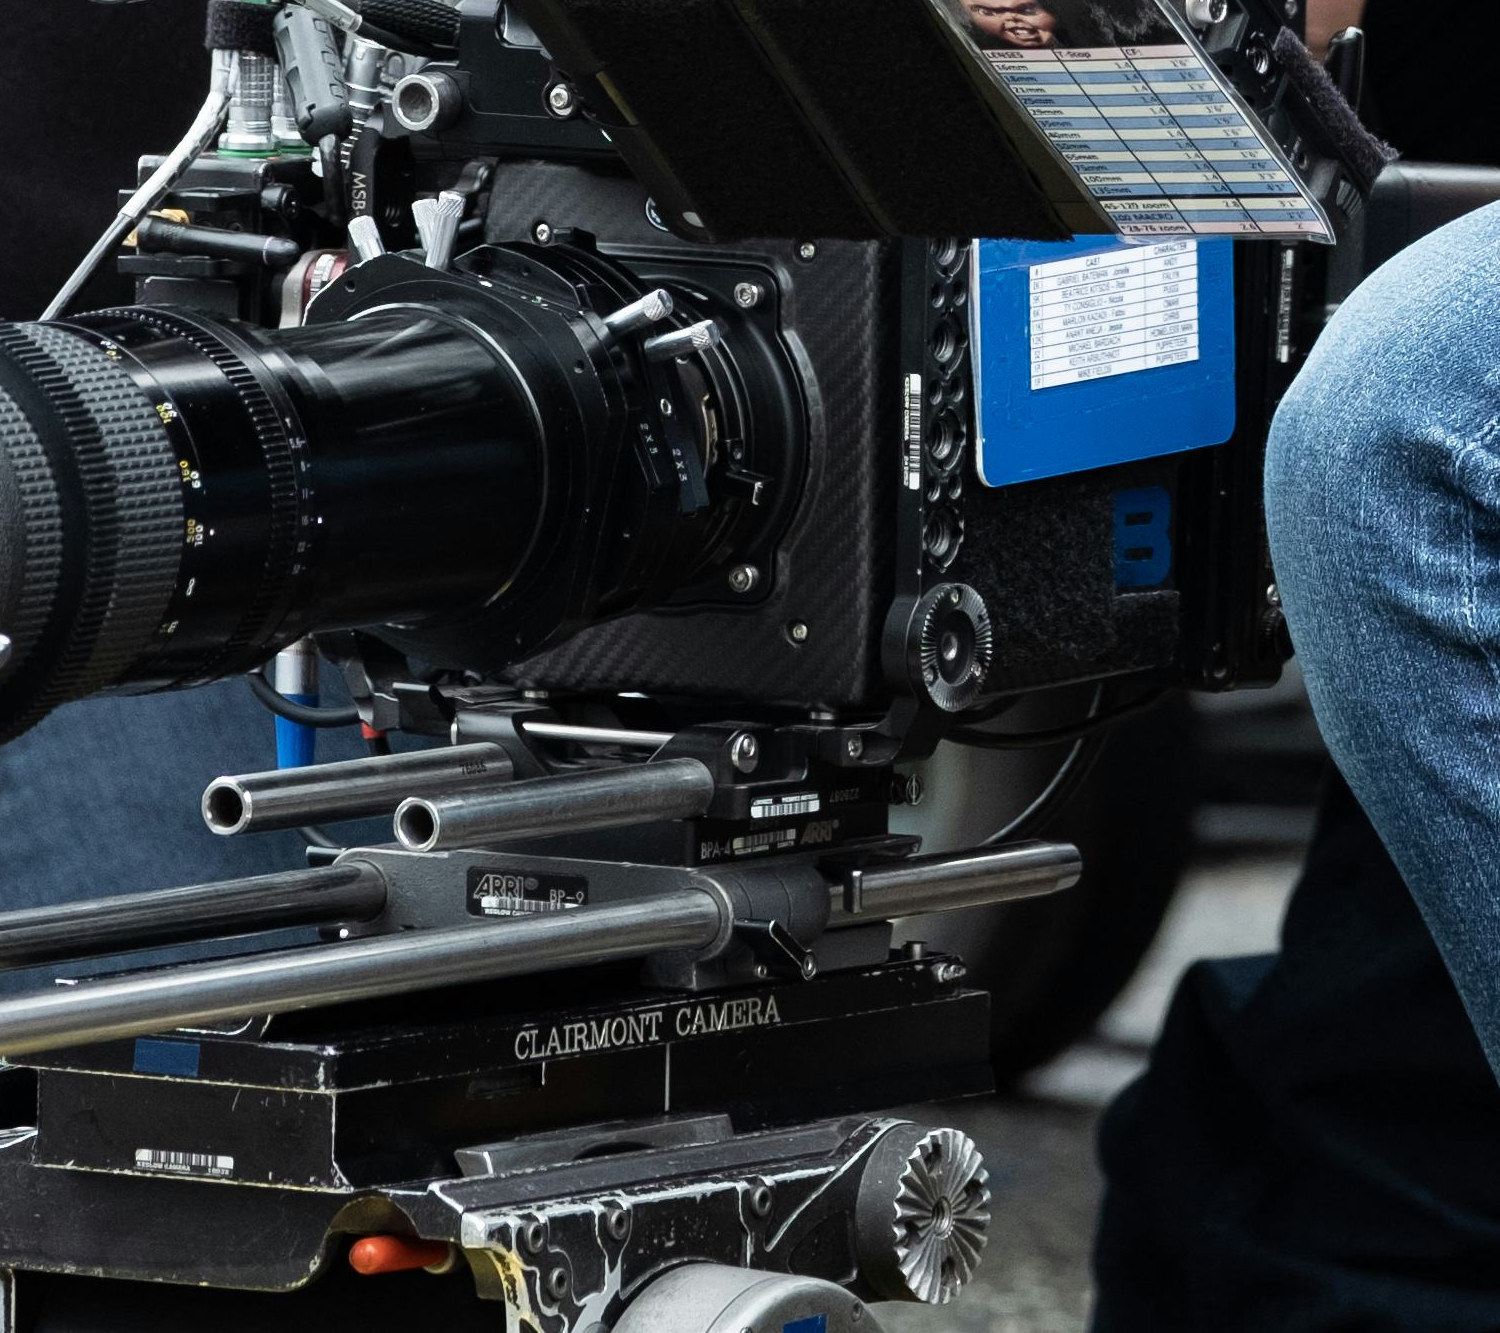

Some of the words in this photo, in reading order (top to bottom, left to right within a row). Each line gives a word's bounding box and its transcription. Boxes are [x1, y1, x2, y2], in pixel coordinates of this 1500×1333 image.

[350, 171, 368, 216] MSB-
[1131, 212, 1176, 221] MACRO
[1085, 257, 1100, 266] CAST
[1113, 485, 1171, 587] B
[473, 874, 524, 901] ARRI
[549, 888, 585, 904] BP-9
[514, 1011, 663, 1061] CLAIRMONT
[675, 994, 781, 1037] CAMERA
